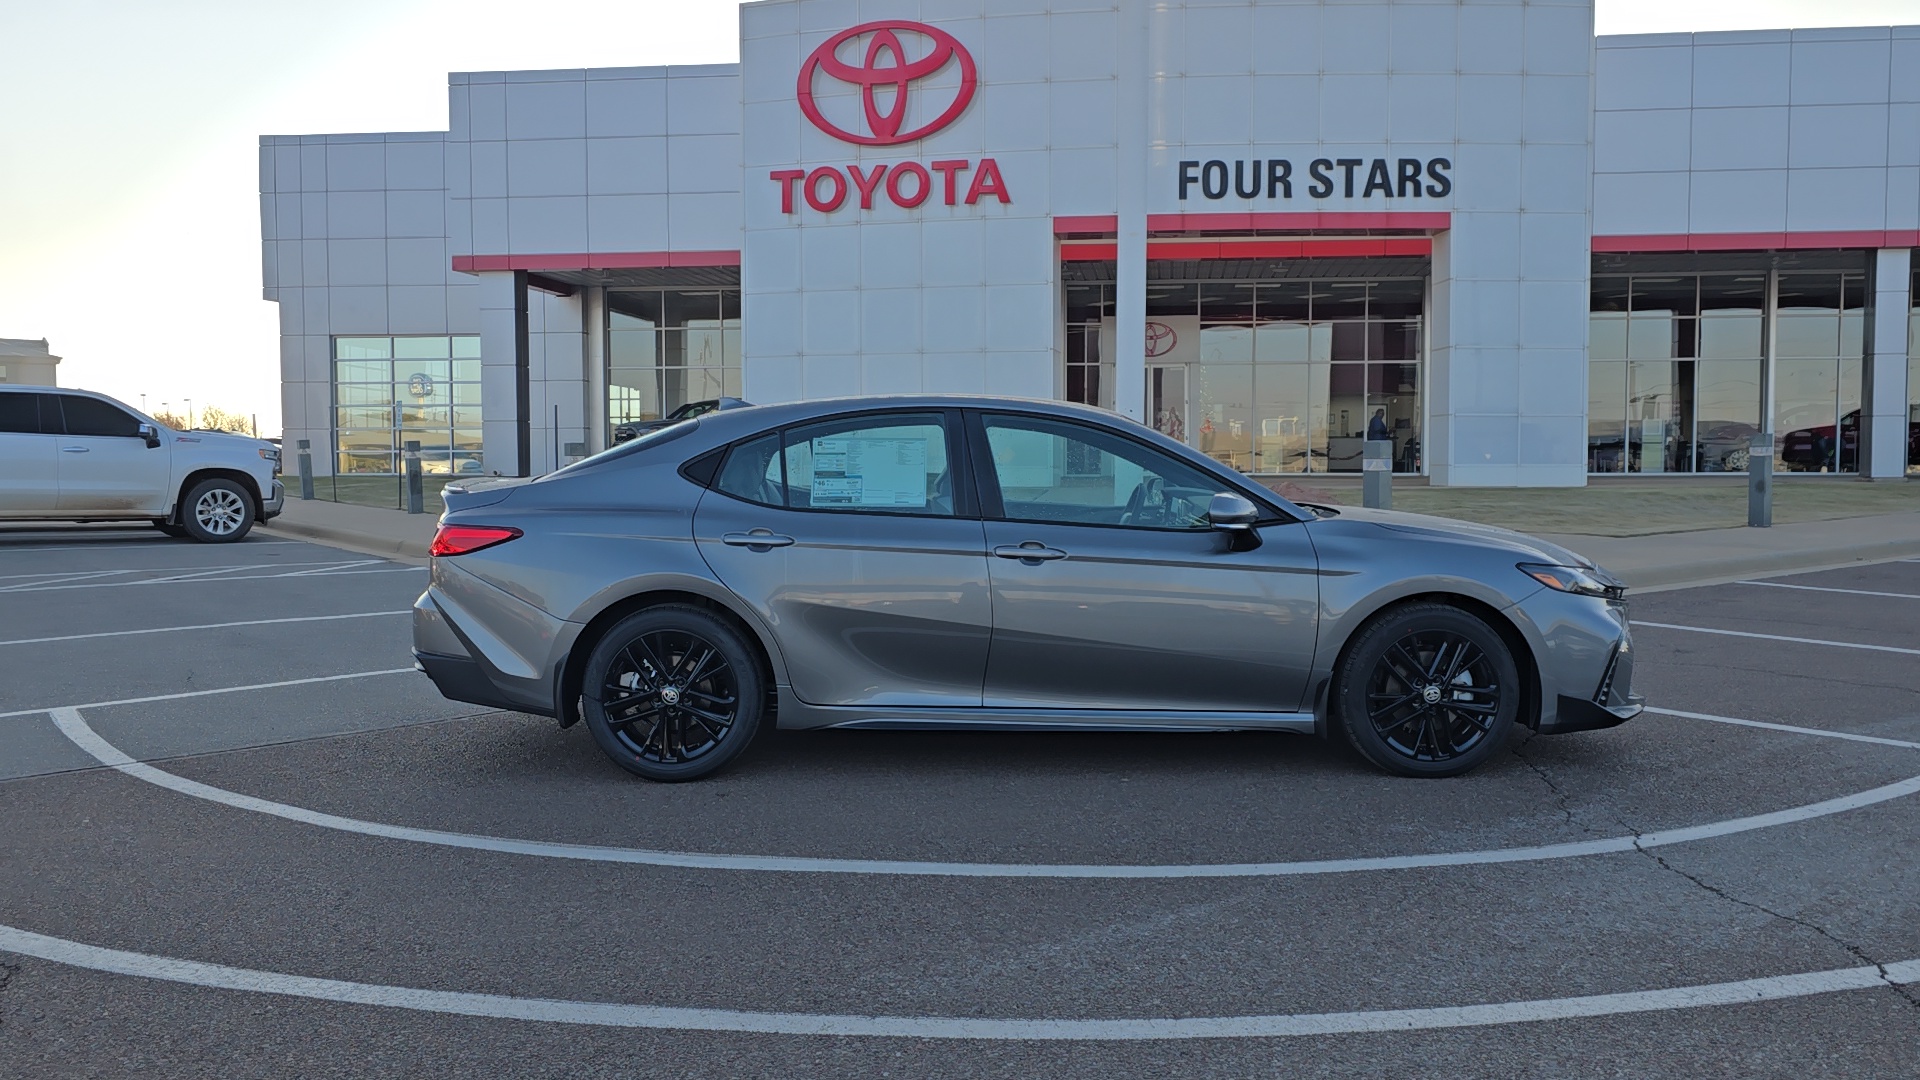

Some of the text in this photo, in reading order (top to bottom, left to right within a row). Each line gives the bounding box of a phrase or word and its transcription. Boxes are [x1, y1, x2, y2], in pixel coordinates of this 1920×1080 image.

[770, 158, 1011, 214] TOYOTA
[1179, 157, 1452, 200] FOUR STARS
